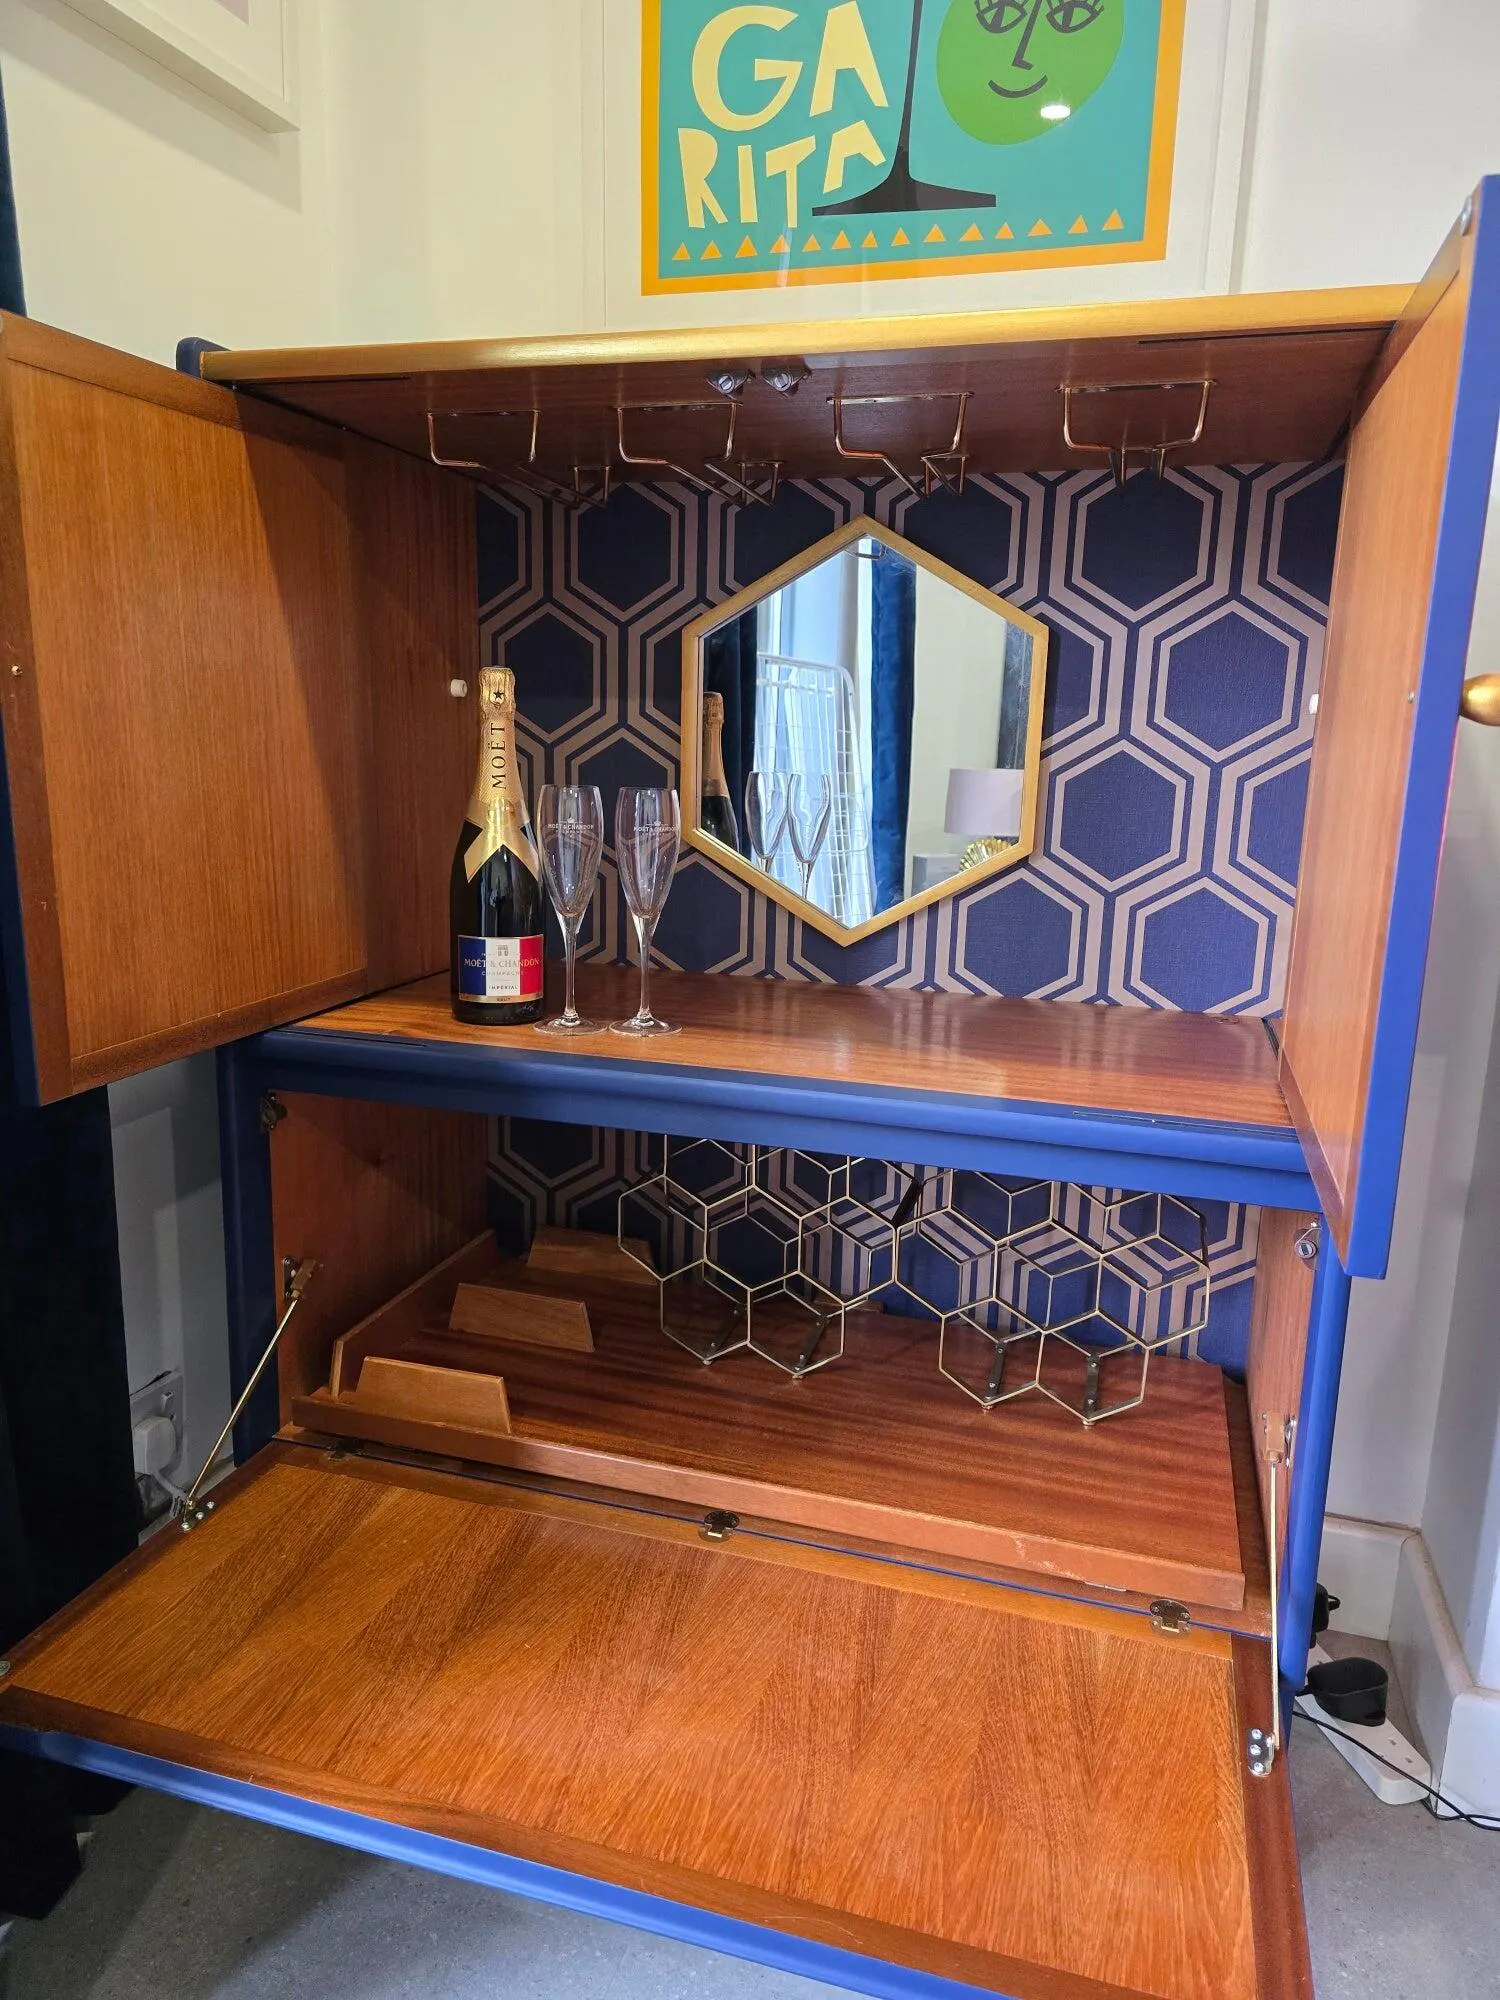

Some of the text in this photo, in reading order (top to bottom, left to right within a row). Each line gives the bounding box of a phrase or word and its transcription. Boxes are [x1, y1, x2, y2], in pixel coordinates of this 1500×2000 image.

[691, 0, 889, 132] GA
[677, 119, 886, 229] RITA
[487, 722, 507, 790] MOËT
[489, 960, 496, 968] &
[498, 958, 540, 968] CHANDON
